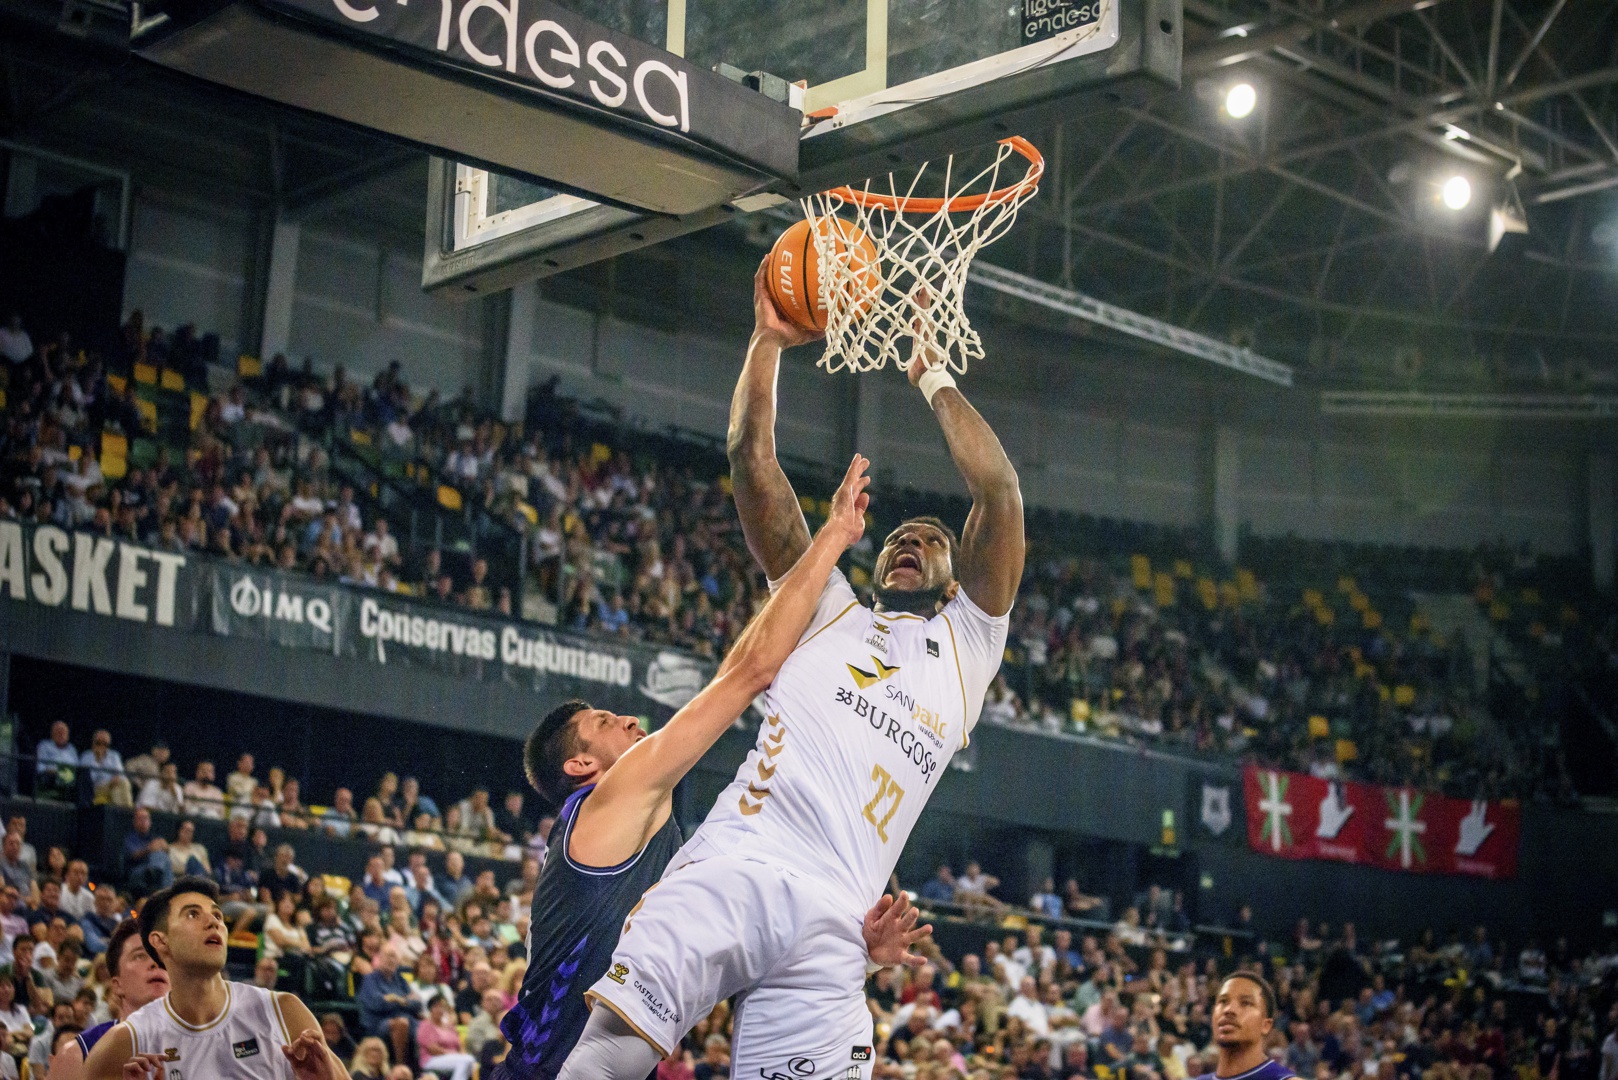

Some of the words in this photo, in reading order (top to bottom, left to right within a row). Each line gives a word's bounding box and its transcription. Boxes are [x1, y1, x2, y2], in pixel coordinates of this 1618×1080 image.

[781, 250, 794, 295] EVO
[263, 589, 332, 633] IMQ
[360, 598, 496, 661] Conservas
[501, 626, 631, 687] Cusumano
[854, 694, 932, 775] BURGOS
[861, 763, 905, 844] 22
[633, 980, 663, 1010] CASTILLA
[852, 1050, 867, 1059] acb
